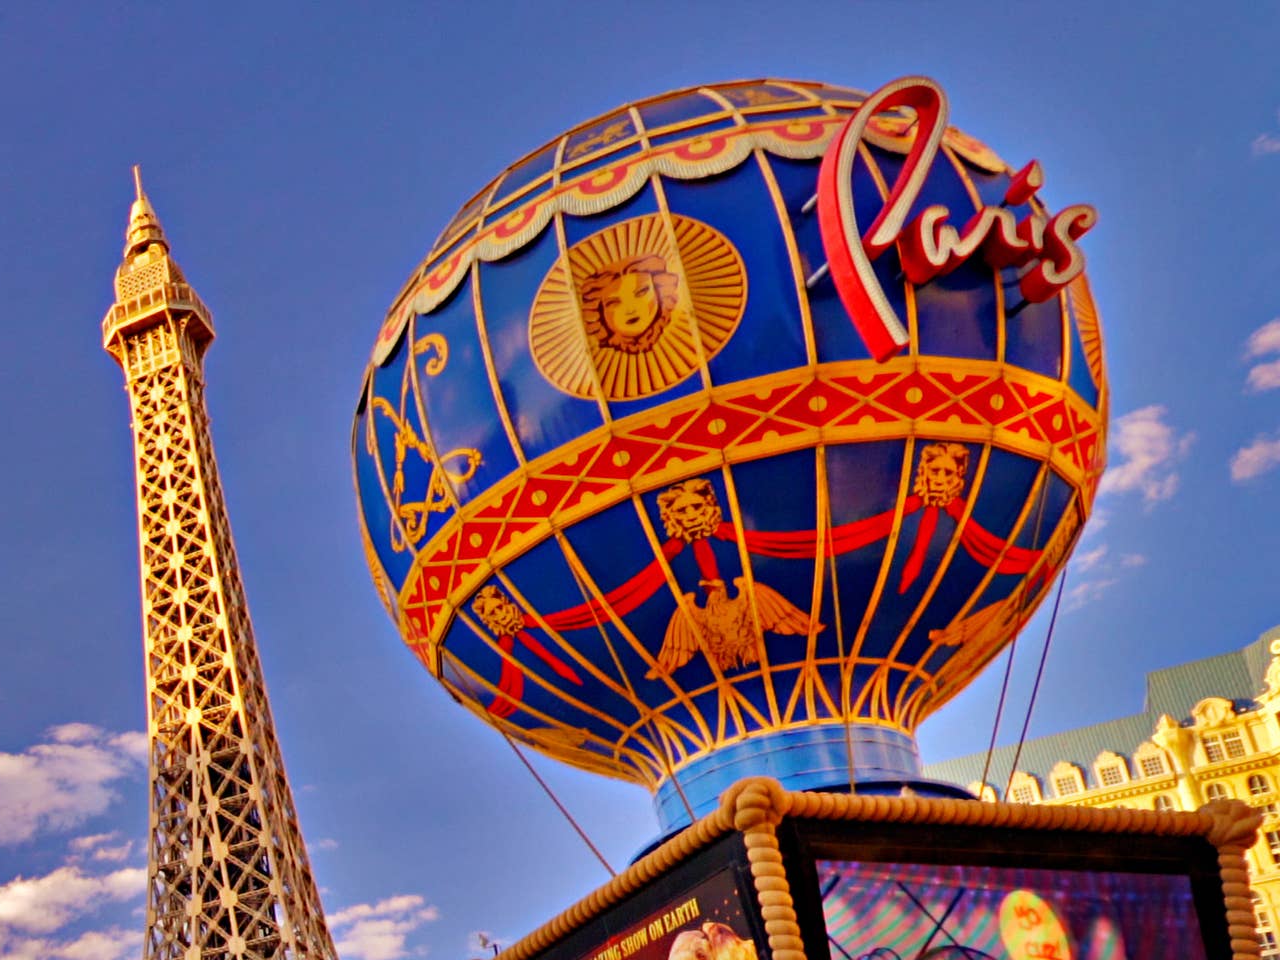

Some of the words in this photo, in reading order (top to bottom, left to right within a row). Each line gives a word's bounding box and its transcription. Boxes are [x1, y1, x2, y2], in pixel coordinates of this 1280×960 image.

[817, 76, 1097, 363] Paris
[620, 928, 648, 958] SHOW
[649, 918, 665, 941] ON
[663, 898, 701, 931] EARTH
